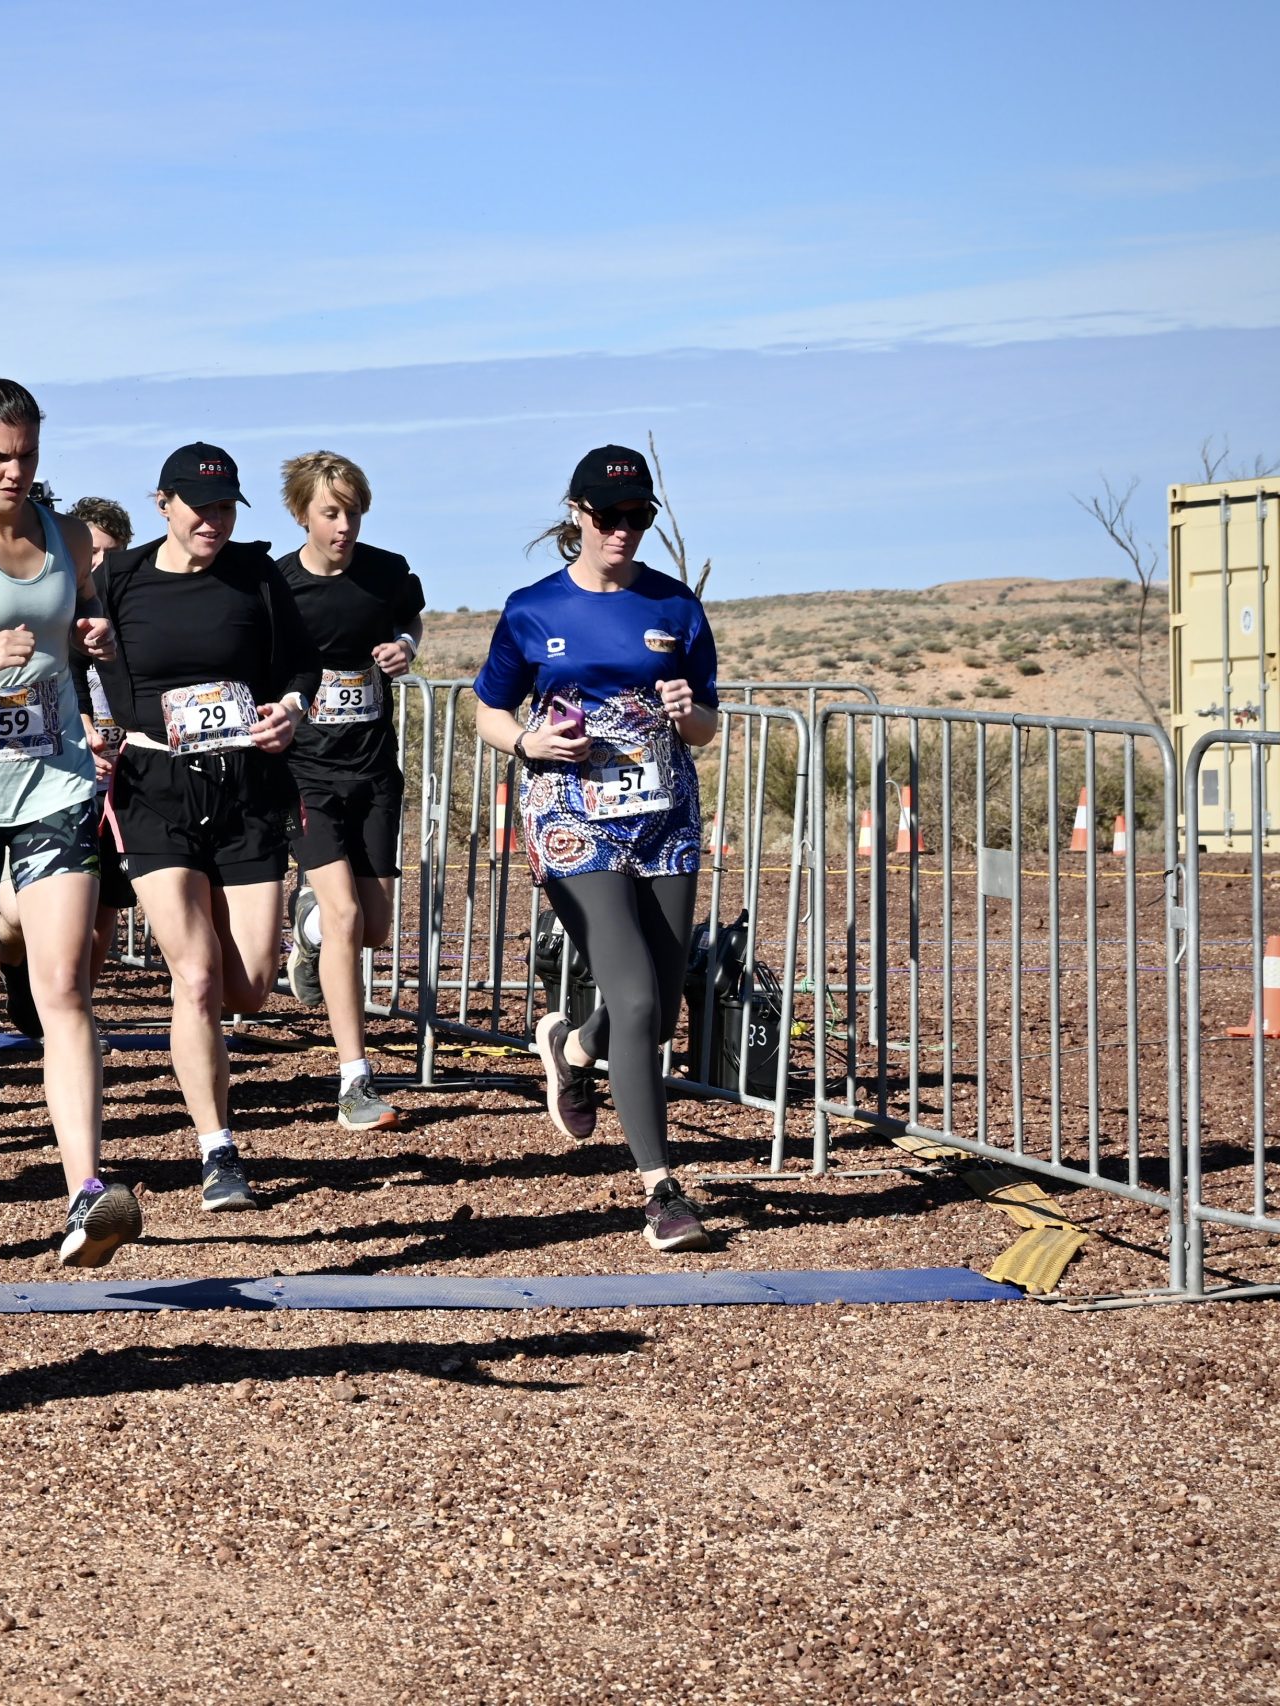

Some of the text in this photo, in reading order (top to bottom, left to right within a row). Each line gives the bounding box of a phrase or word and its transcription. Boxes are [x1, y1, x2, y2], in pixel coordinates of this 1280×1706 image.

[339, 689, 363, 706] 93
[0, 709, 30, 736] 59
[199, 705, 226, 729] 29
[619, 766, 645, 791] 57
